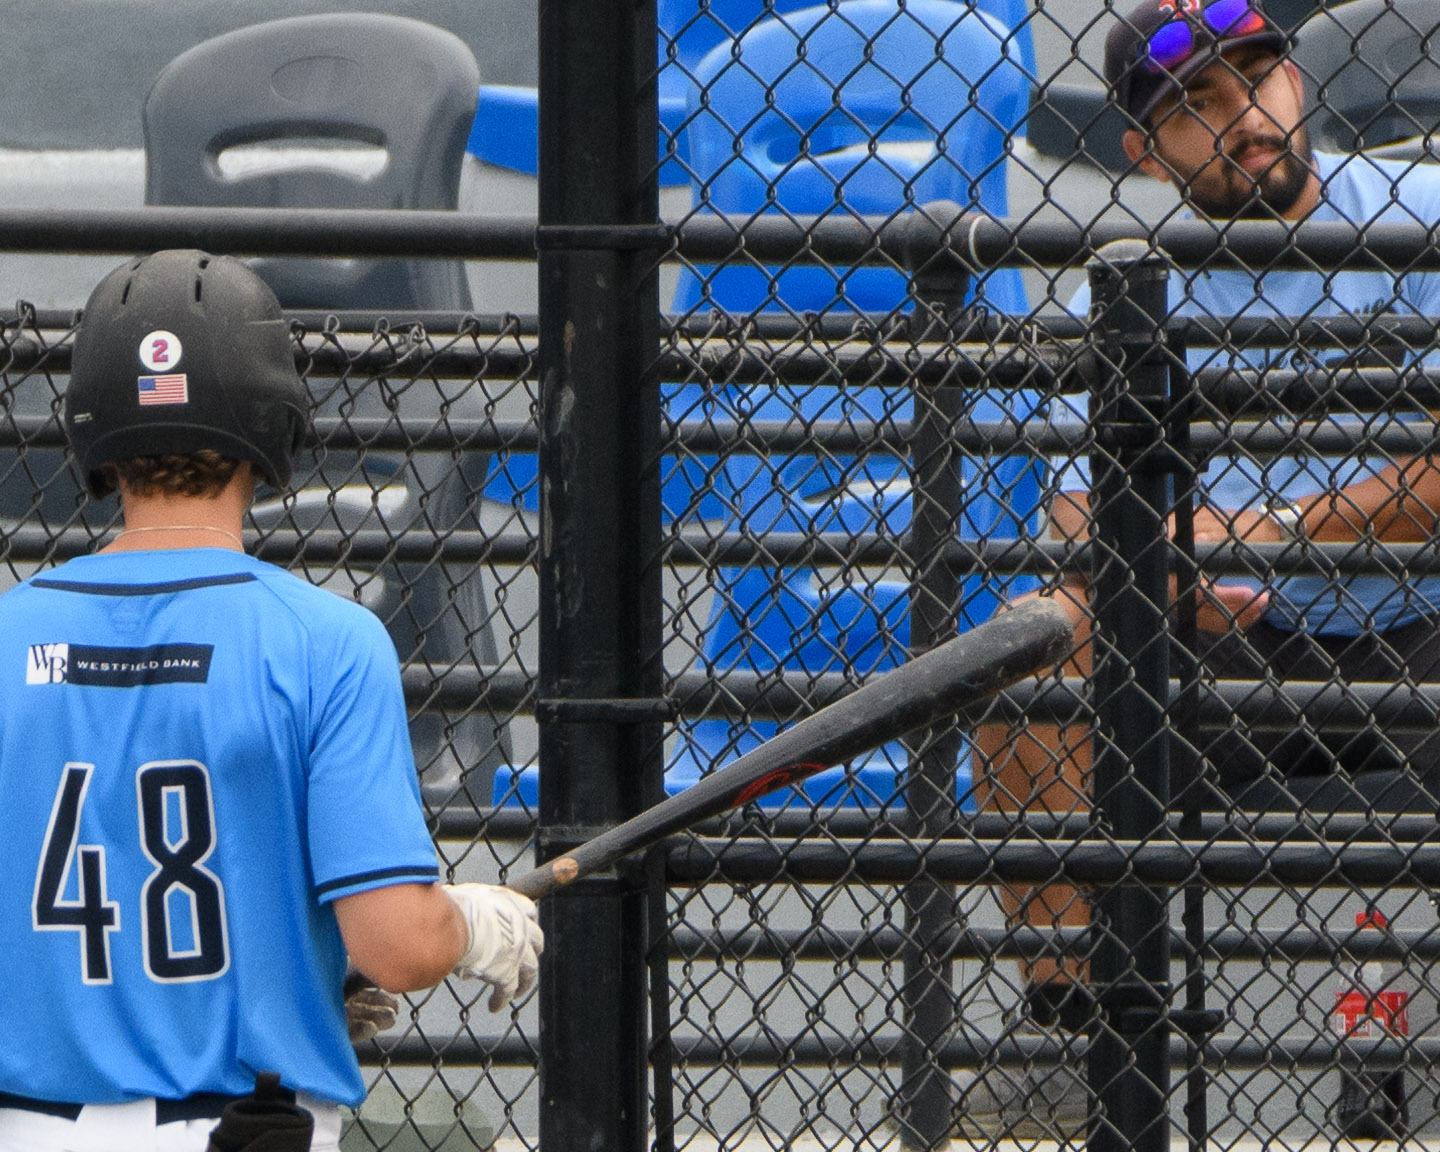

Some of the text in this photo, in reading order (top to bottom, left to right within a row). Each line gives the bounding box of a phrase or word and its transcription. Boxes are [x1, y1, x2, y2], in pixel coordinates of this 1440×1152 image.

[152, 340, 168, 362] 2
[75, 658, 201, 672] WESTFIELD BANK
[31, 758, 231, 987] 48
